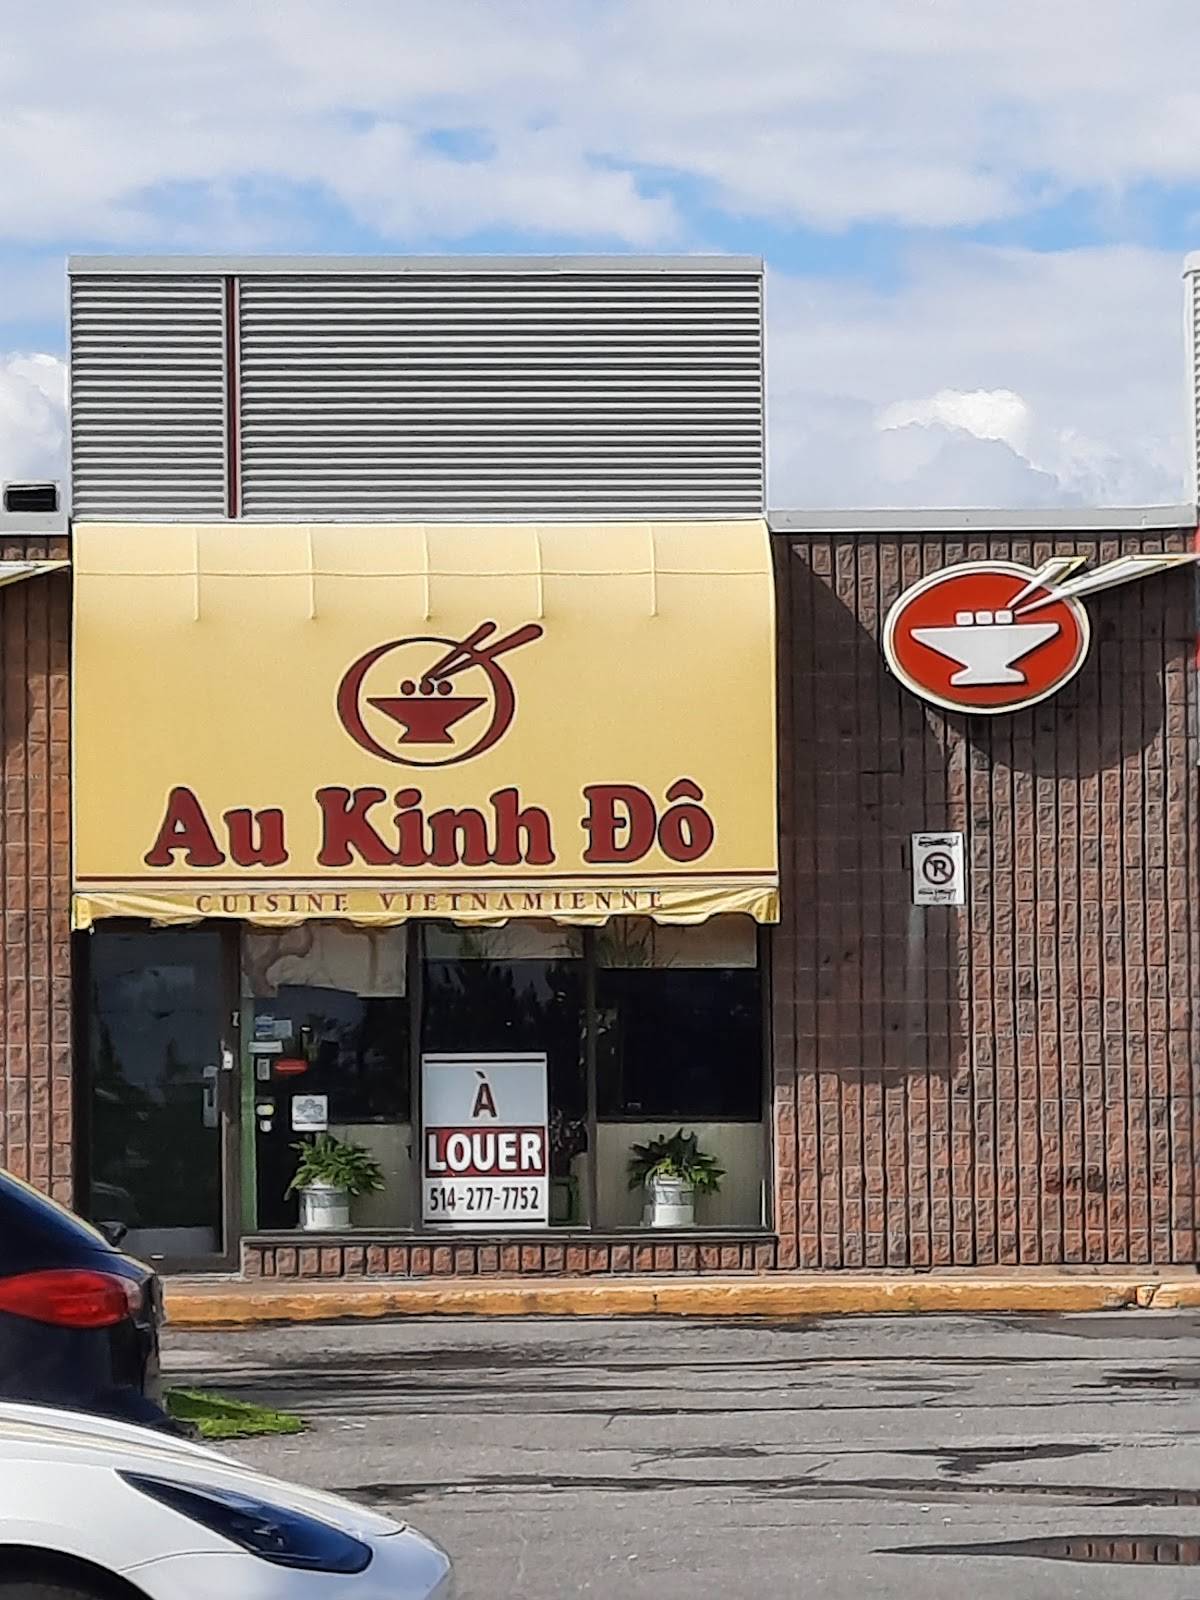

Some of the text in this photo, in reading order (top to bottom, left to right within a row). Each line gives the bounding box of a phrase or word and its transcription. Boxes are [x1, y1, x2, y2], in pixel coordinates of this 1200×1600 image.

[144, 778, 715, 867] Au Kinh Đô
[196, 890, 664, 912] CUISINE VIETNAMIENNE
[472, 1070, 498, 1118] À
[427, 1132, 543, 1172] LOUER
[430, 1186, 539, 1211] 514-277-7752
